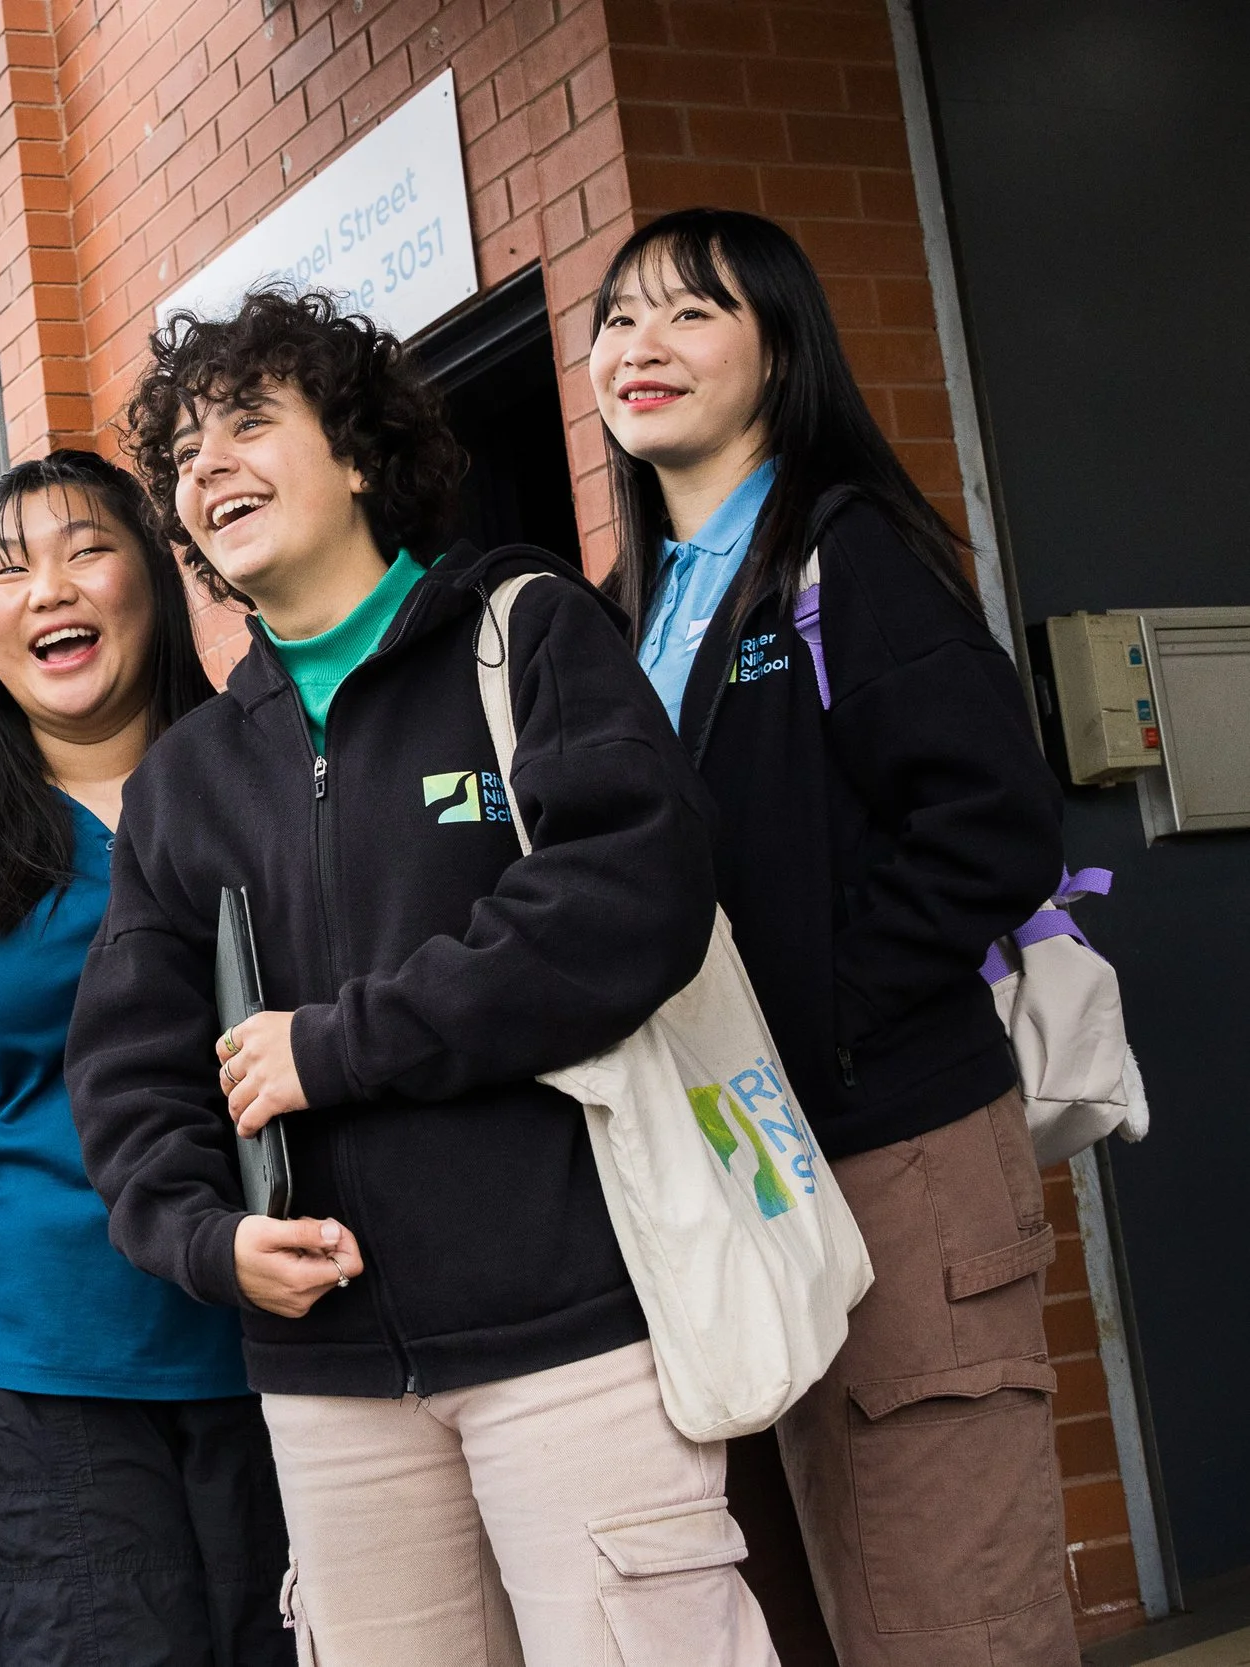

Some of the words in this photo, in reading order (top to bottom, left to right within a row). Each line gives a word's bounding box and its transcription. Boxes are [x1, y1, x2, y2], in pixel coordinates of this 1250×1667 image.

[339, 167, 418, 252] Street
[381, 217, 444, 293] 3051
[483, 788, 509, 806] Nil
